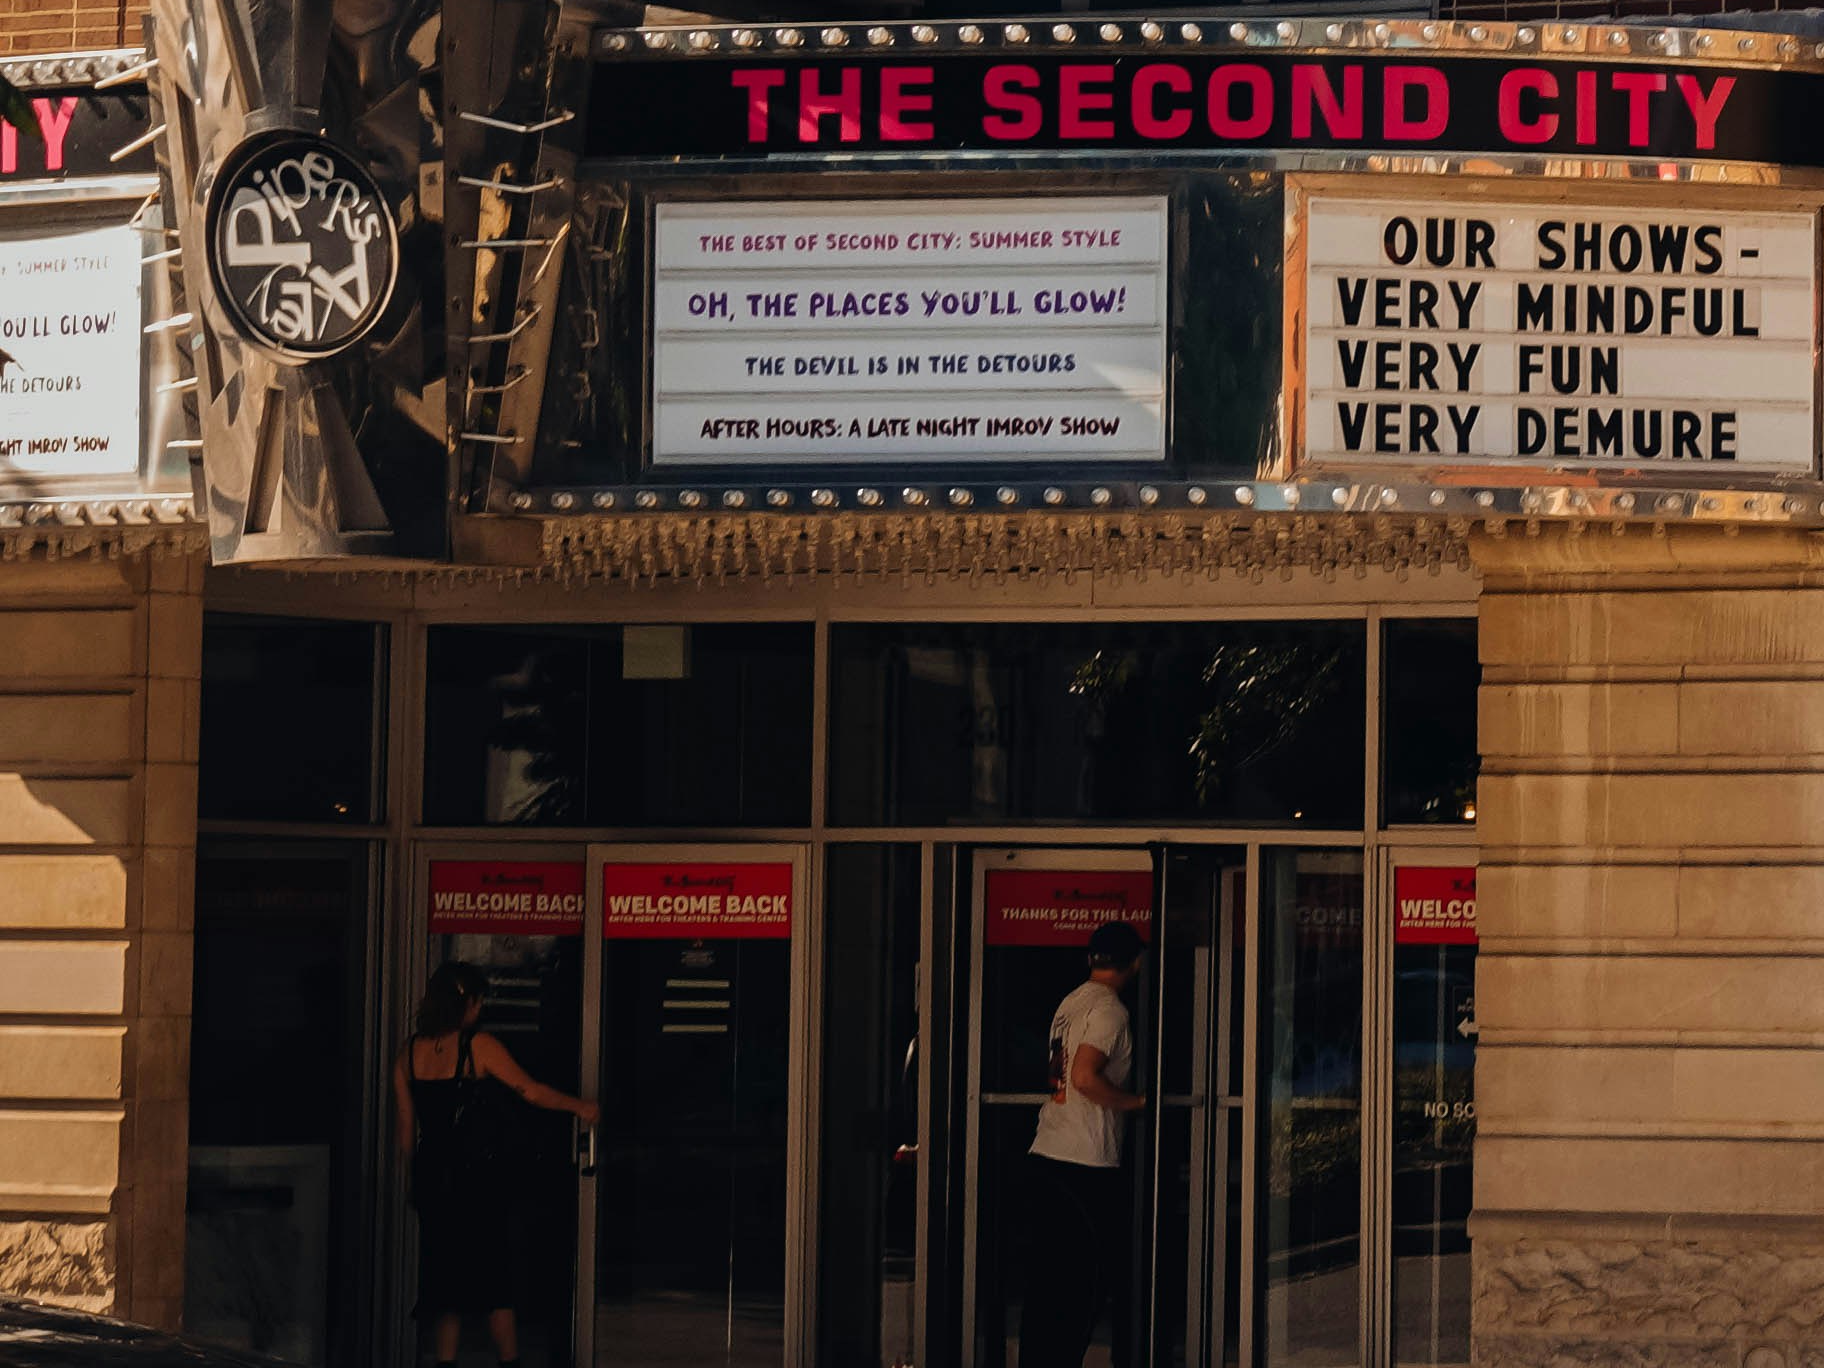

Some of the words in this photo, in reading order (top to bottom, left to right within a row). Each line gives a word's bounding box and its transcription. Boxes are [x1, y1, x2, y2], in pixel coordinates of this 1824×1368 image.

[731, 67, 935, 143] THE
[982, 63, 1450, 141] SECOND
[1498, 68, 1738, 150] CITY
[700, 235, 735, 252] THE
[742, 235, 787, 252] BEST
[794, 233, 819, 251] OF
[826, 233, 899, 251] SECOND
[907, 231, 961, 250] CITY:
[970, 231, 1053, 249] SUMMER
[1062, 229, 1122, 247] STYLE
[1383, 216, 1496, 269] OUR
[688, 292, 736, 322] OH,
[746, 293, 799, 317] THE
[809, 291, 910, 318] PLACES
[921, 289, 1023, 318] YOU'LL
[1034, 285, 1127, 316] GLOW!
[1337, 277, 1483, 330] VERY
[1517, 283, 1760, 338] MINDFUL
[60, 311, 116, 335] GLOW!
[745, 357, 786, 376] THE
[794, 356, 859, 376] DEVIL
[868, 356, 889, 376] IS
[897, 355, 920, 374] IN
[928, 354, 969, 374] THE
[977, 353, 1077, 373] DETOURS
[1338, 339, 1481, 391] VERY
[1519, 345, 1619, 395] FUN
[22, 375, 82, 393] DETOURS
[700, 418, 761, 439] AFTER
[766, 418, 842, 439] HOURS:
[848, 418, 862, 438] A
[867, 418, 911, 438] LATE
[916, 416, 981, 438] NIGHT
[1060, 416, 1121, 437] SHOW
[1338, 401, 1480, 454] VERY
[1517, 407, 1737, 460] DEMURE
[73, 435, 110, 453] SHOW
[434, 892, 532, 912] WELCOME
[609, 895, 721, 915] WELCOME
[726, 895, 787, 915] BACK
[1400, 899, 1476, 919] WELCO
[1001, 907, 1058, 920] THANKS
[1061, 908, 1089, 921] FOR
[1091, 908, 1119, 921] THE
[1121, 909, 1152, 921] LAU
[1424, 1101, 1448, 1119] NO
